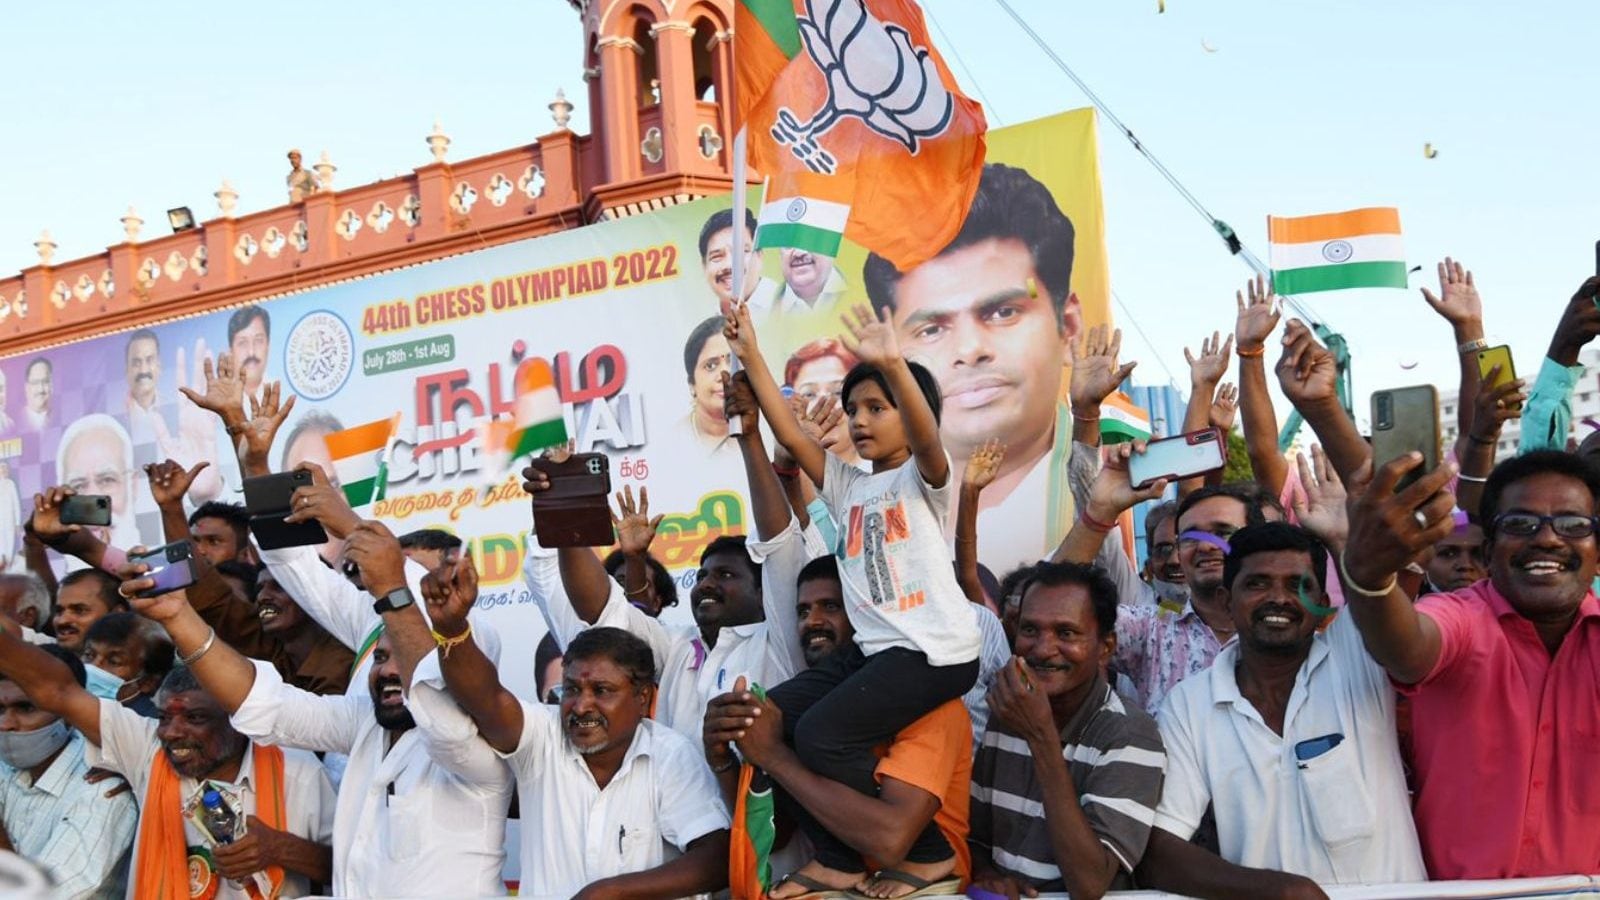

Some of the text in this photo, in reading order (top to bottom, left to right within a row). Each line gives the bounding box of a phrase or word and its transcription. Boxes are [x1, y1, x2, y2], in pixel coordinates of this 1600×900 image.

[363, 245, 678, 335] 44th CHESS OLYMPIAD 2022
[364, 352, 385, 370] July
[386, 348, 407, 366] 28th
[414, 345, 429, 359] 1st
[430, 341, 450, 358] Aug
[386, 392, 649, 487] CHEAI
